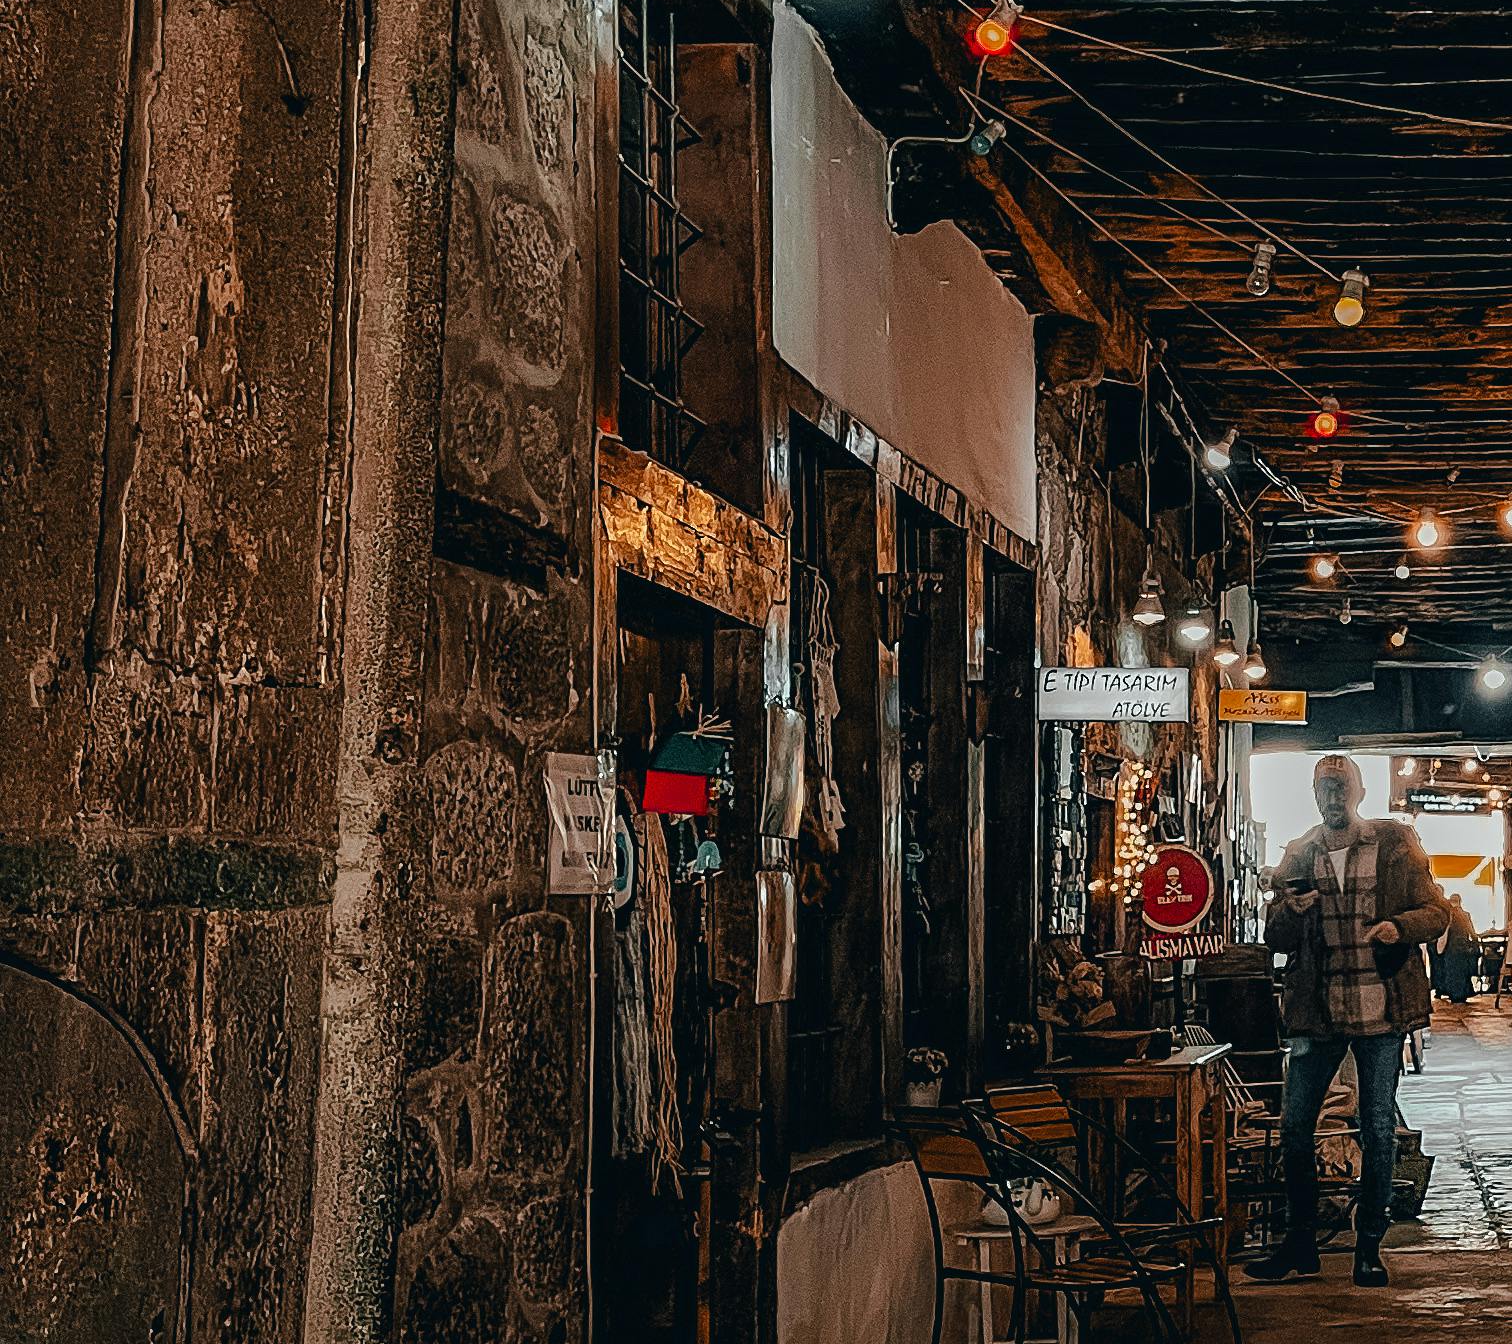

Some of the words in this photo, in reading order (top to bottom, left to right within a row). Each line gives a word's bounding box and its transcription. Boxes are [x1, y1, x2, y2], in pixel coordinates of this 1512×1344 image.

[1043, 669, 1058, 693] E
[1101, 673, 1178, 693] TASARIM
[1111, 699, 1172, 719] ATÖLYE
